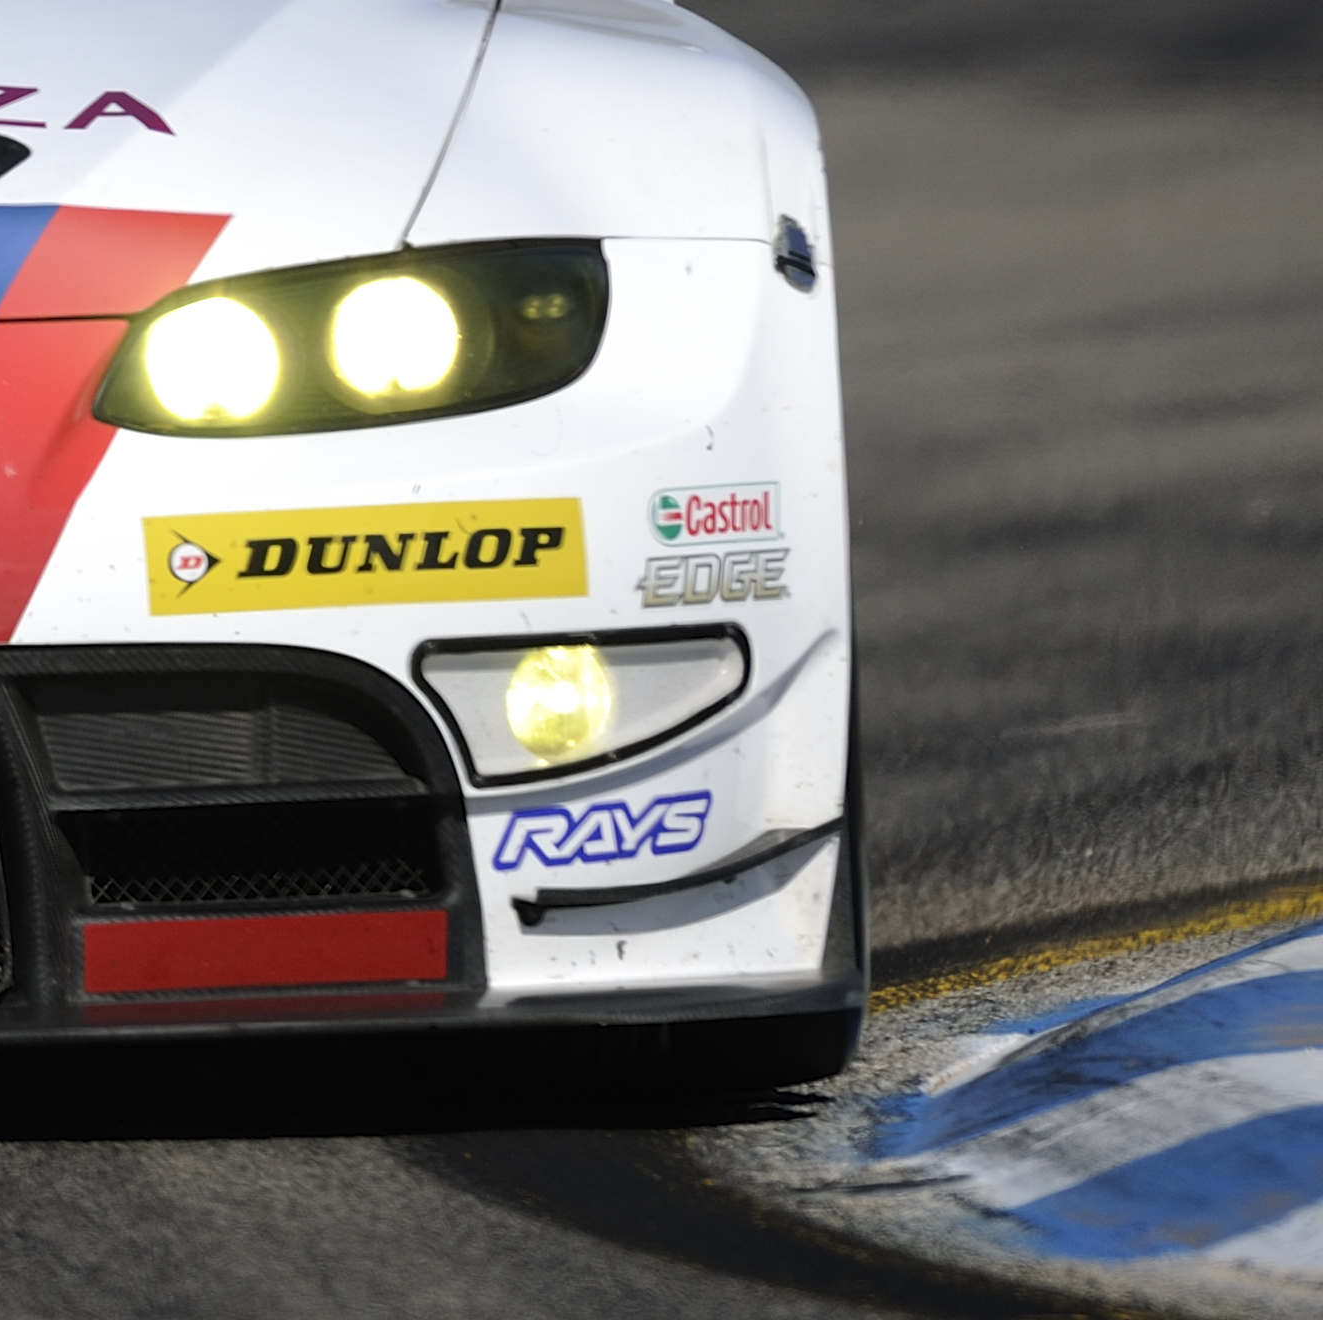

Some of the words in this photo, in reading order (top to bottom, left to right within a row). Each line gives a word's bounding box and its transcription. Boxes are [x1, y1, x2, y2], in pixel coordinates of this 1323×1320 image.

[683, 489, 772, 536] Castrol
[236, 526, 566, 579] DUNLOP
[635, 547, 792, 609] EDGE
[491, 790, 713, 871] RAYS
